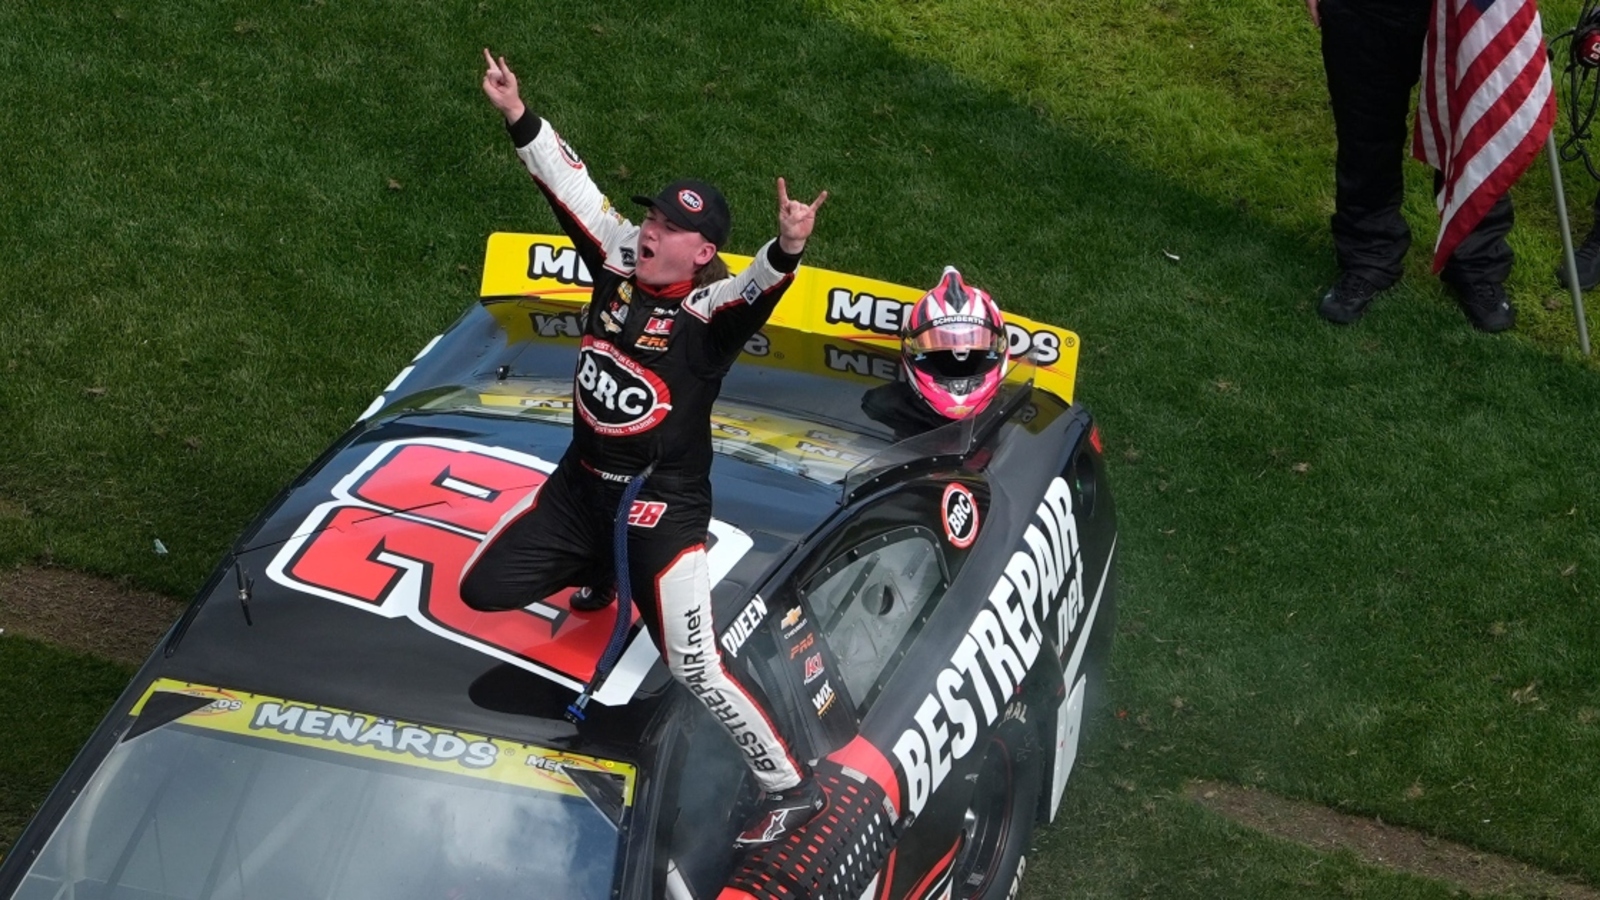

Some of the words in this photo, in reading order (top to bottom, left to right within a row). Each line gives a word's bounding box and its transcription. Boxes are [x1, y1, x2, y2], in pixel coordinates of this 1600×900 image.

[826, 287, 1060, 366] MEDS
[932, 315, 985, 327] SCHUBERTH
[577, 352, 648, 416] BRC
[601, 471, 633, 484] QUEE
[627, 500, 667, 528] 28
[948, 493, 972, 536] BRC
[720, 593, 768, 658] QUEEN
[892, 476, 1080, 828] BESTREPAIR
[811, 679, 834, 710] WIX
